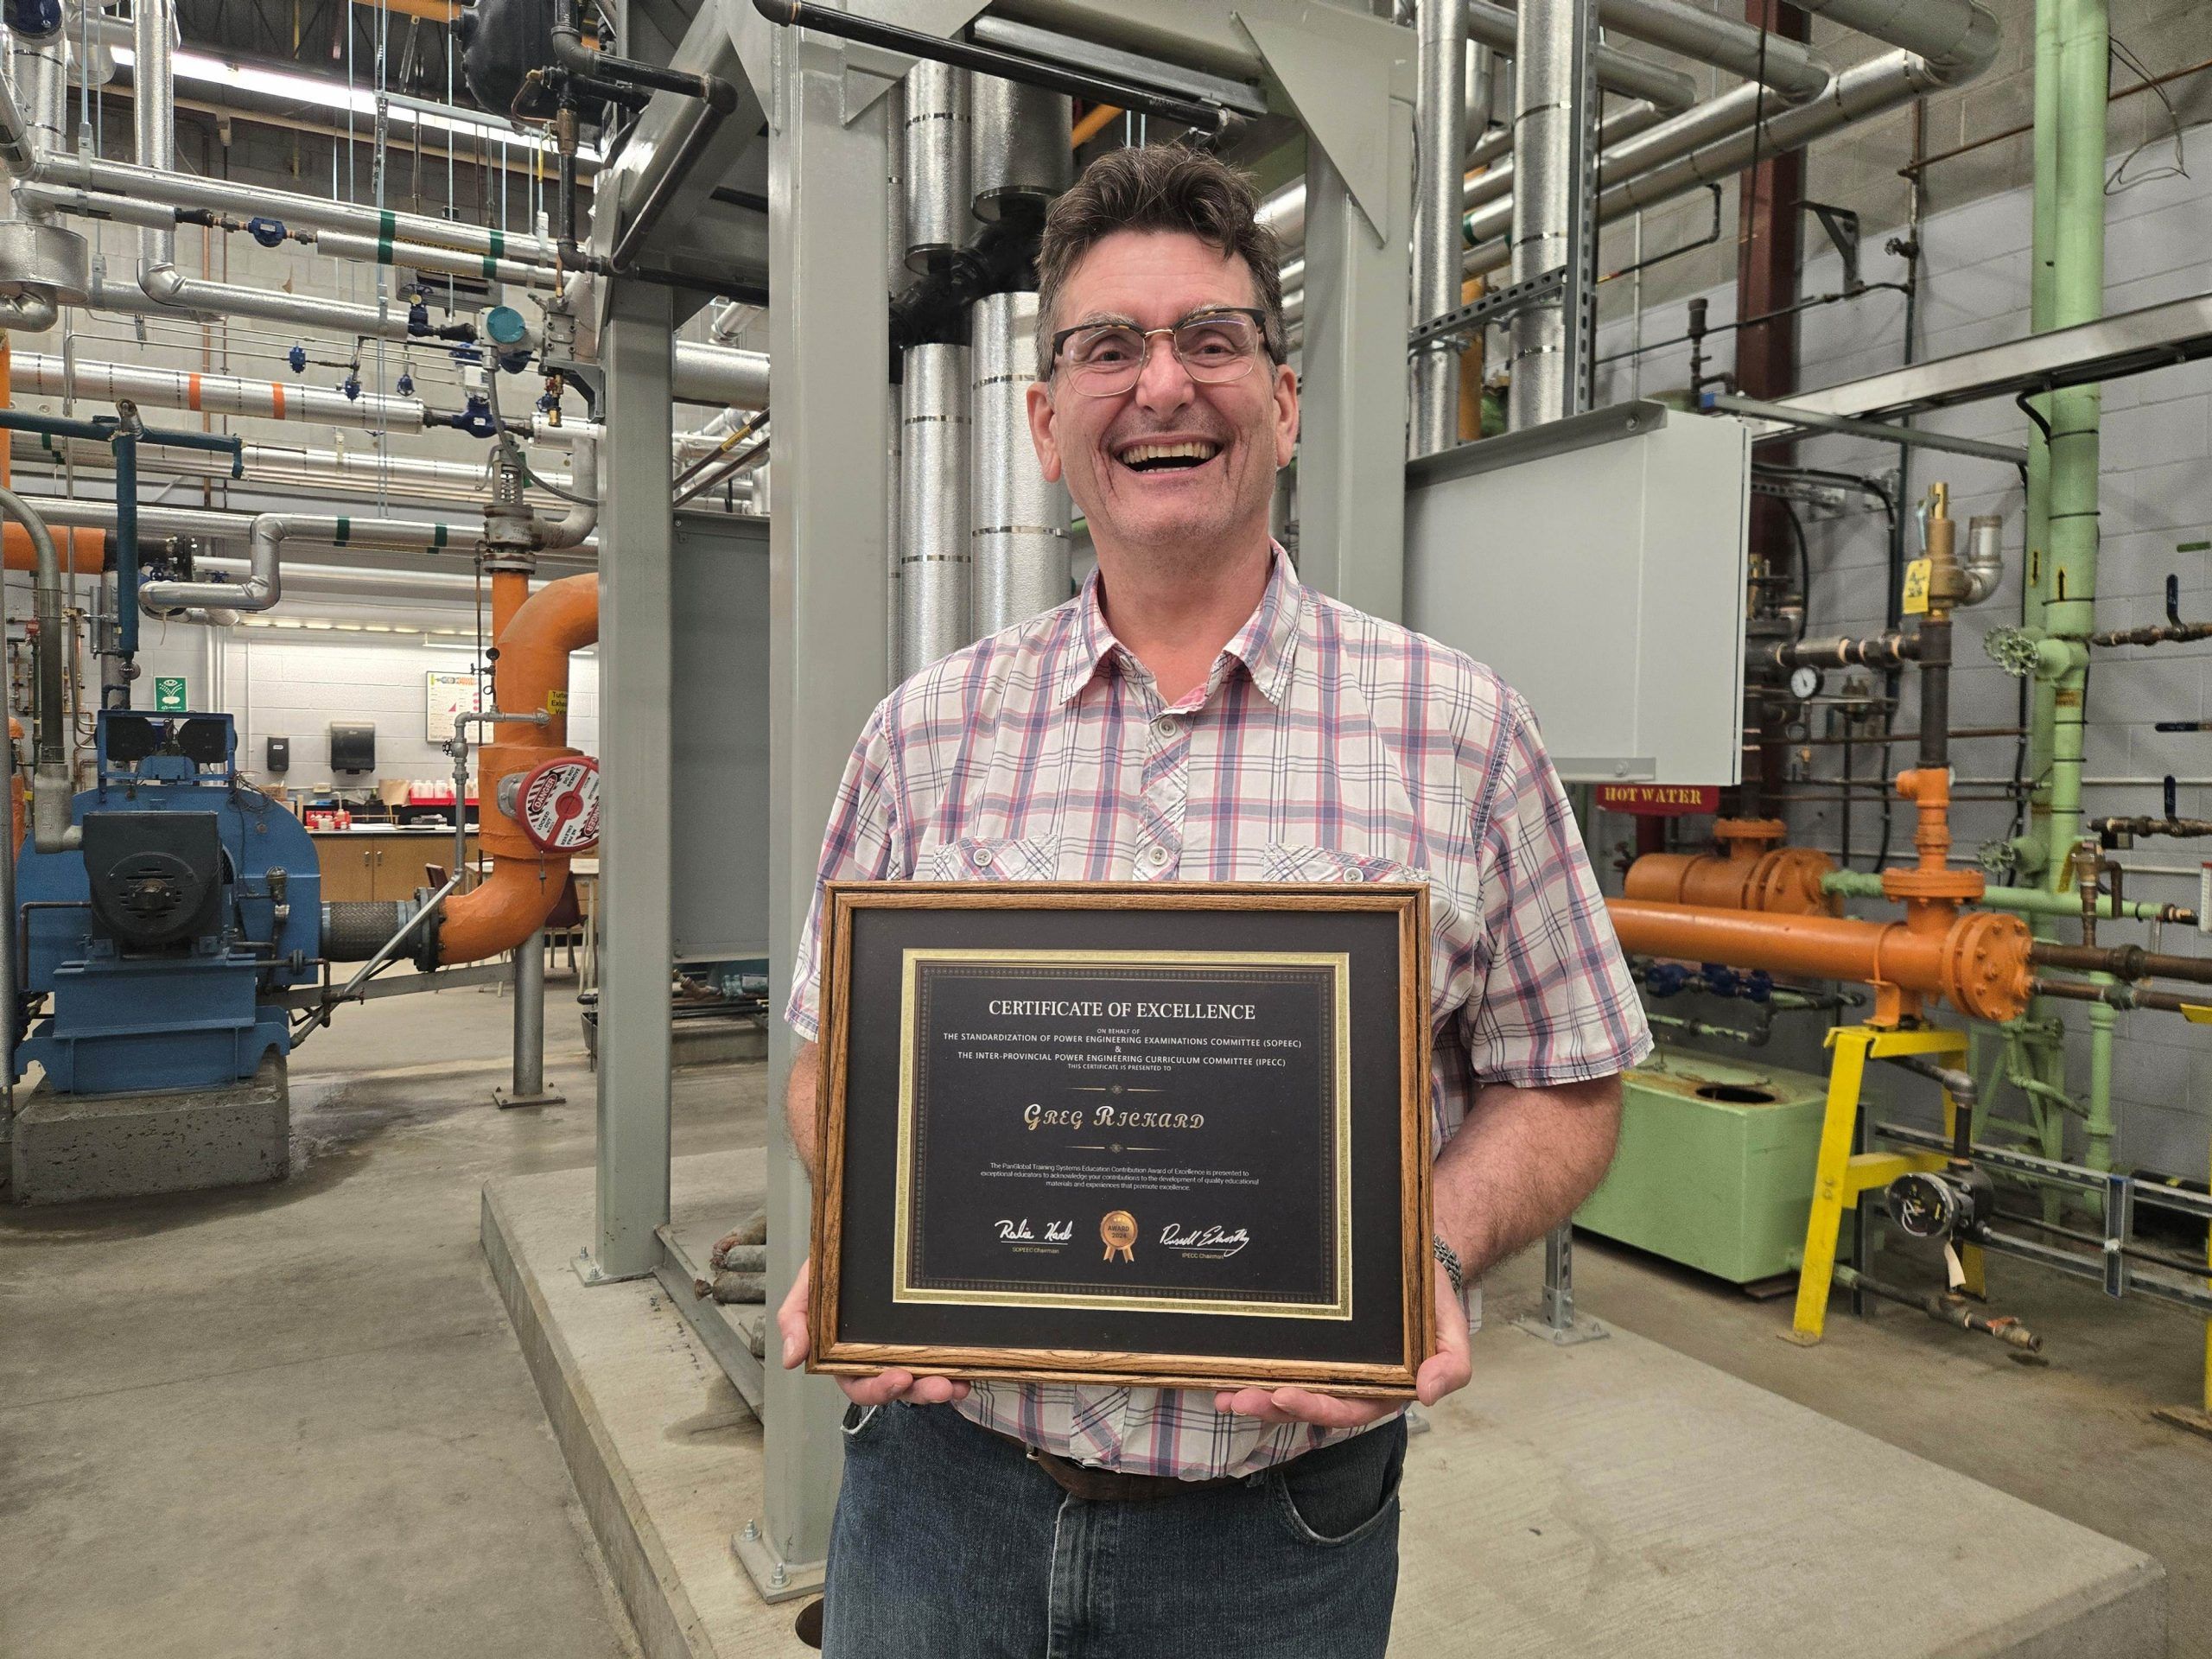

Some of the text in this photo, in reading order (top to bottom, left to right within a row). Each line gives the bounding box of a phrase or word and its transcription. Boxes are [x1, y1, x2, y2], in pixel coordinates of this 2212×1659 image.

[567, 768, 581, 787] REMOVE
[535, 778, 556, 808] DANGER
[1605, 787, 1701, 804] HOT WATER
[537, 810, 550, 830] LOCKED
[988, 1000, 1255, 1020] CERTIFICATE OF EXCELLENCE
[961, 1033, 1038, 1042] STANDARDIZATION
[1053, 1034, 1083, 1043] POWER
[1085, 1035, 1141, 1044] ENGINEERING
[1144, 1037, 1208, 1046] EXAMINATIONS
[1211, 1038, 1261, 1046] COMMITTEE
[1263, 1039, 1302, 1049] (SOPEEC)
[957, 1051, 1287, 1067] THE INTER-PROVINCIAL POWER ENGINEERING CURRICULUM COMMITTEE (IPECC)
[1023, 1103, 1205, 1131] GREG RICKARD
[1033, 1163, 1055, 1172] Training
[1050, 1172, 1088, 1180] acknowledge
